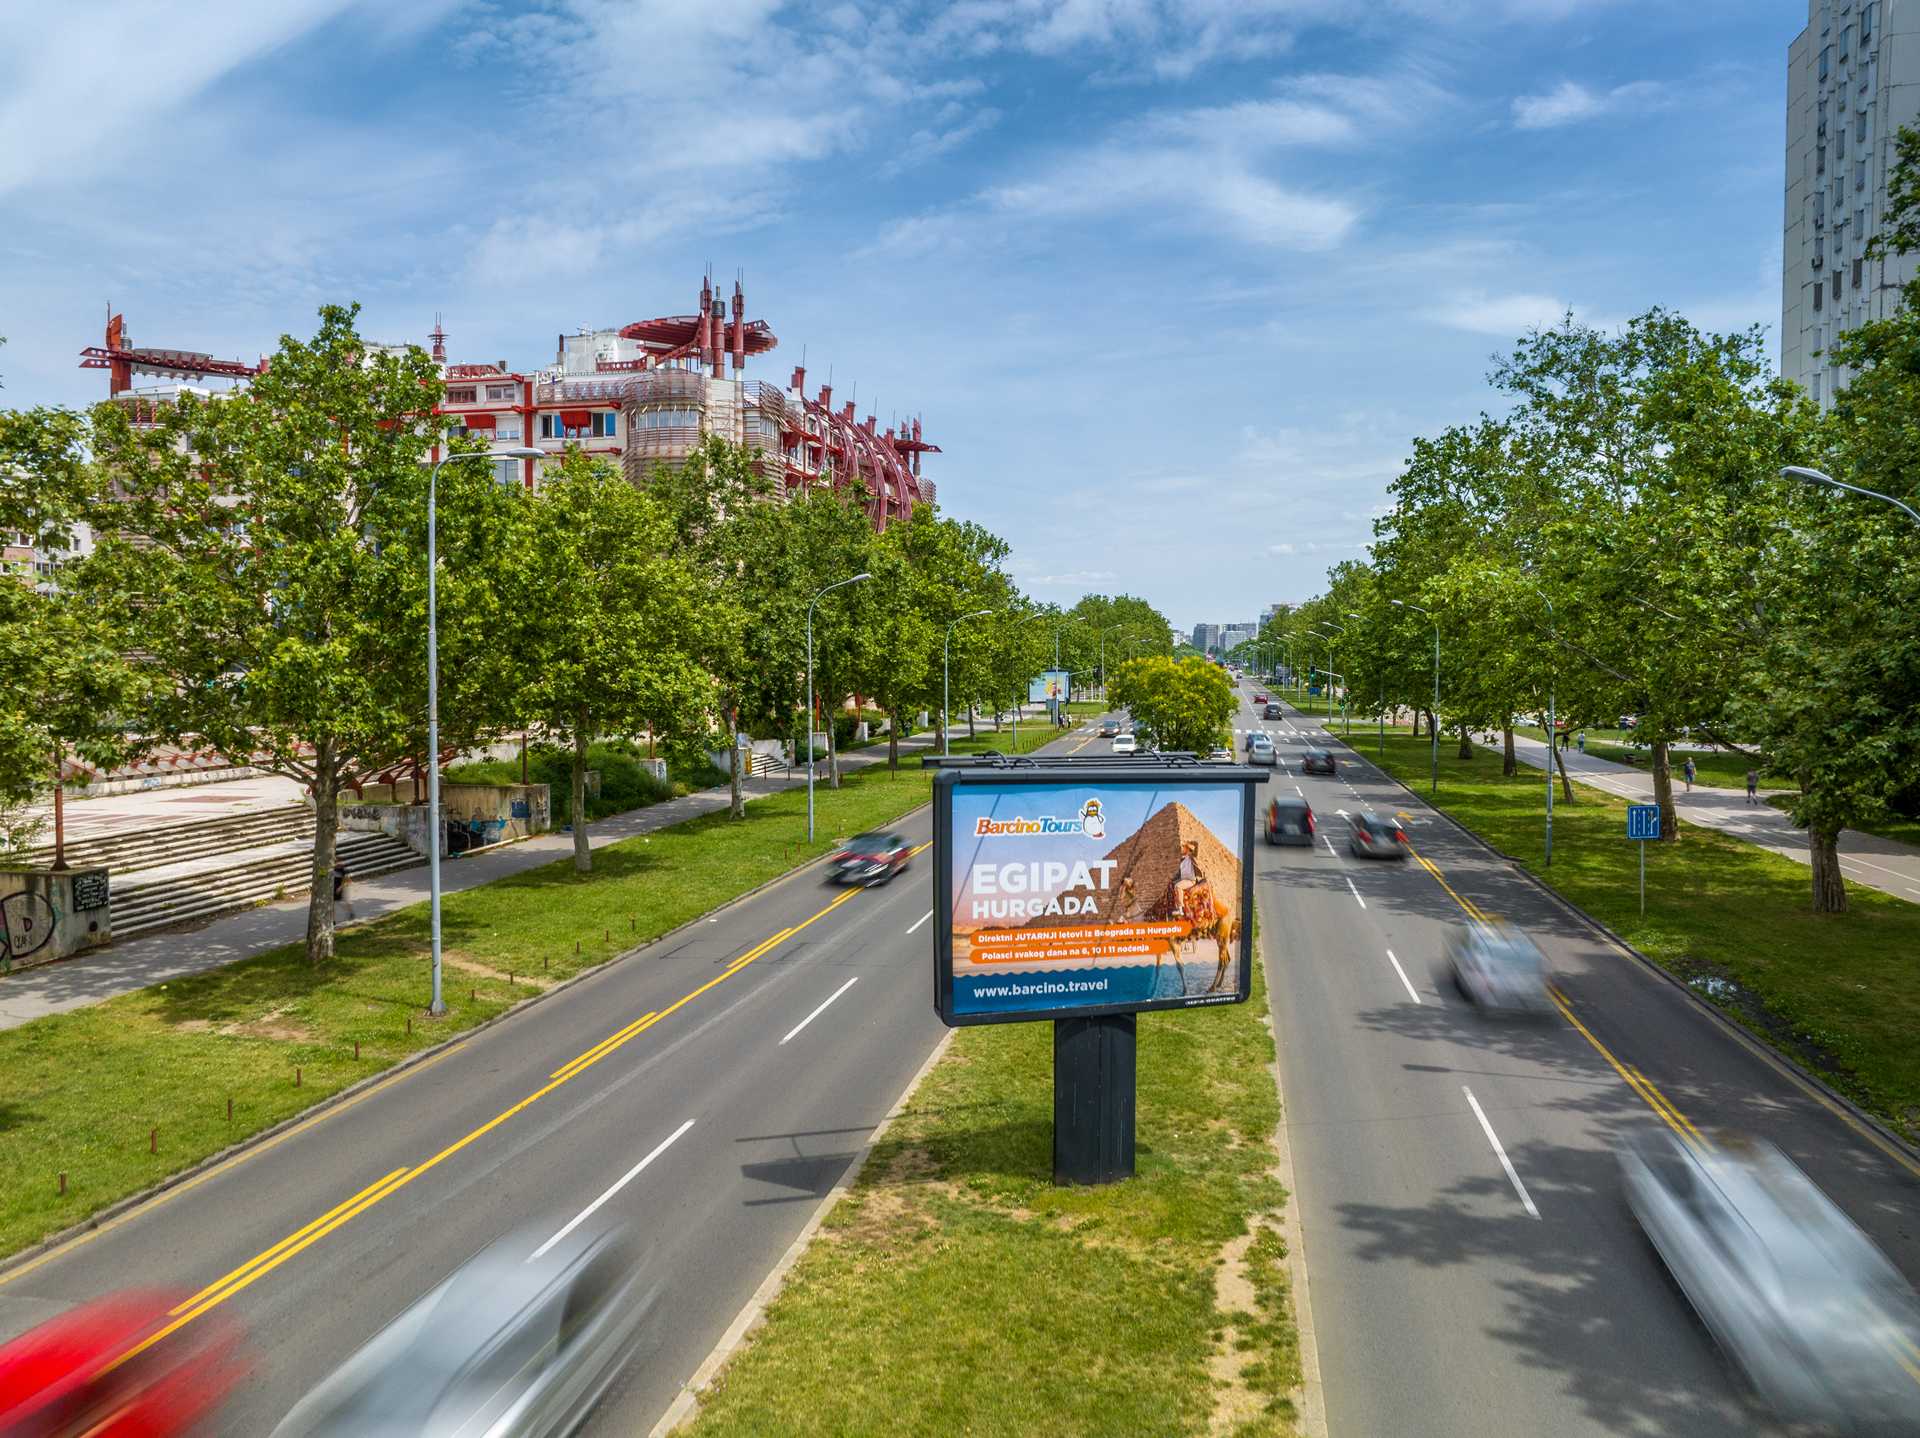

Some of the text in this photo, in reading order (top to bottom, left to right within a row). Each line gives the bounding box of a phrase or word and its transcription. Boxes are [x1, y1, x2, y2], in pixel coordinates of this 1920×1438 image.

[976, 818, 1082, 834] BarcinoTours
[972, 859, 1118, 894] EGIPAT
[972, 895, 1099, 920] HURGADA
[978, 934, 1013, 943] Direktni
[1015, 932, 1057, 941] JUTARNJI
[1059, 930, 1083, 938] letovi
[1085, 929, 1093, 937] iz
[1094, 927, 1134, 937] Beograda
[1147, 925, 1182, 936] Hurgadu
[982, 951, 1013, 960] Polasci
[1014, 950, 1045, 960] svakog
[1047, 948, 1068, 957] dana
[1069, 948, 1081, 956] na
[1092, 946, 1102, 955] 10
[973, 978, 1108, 998] www.barcino.travel
